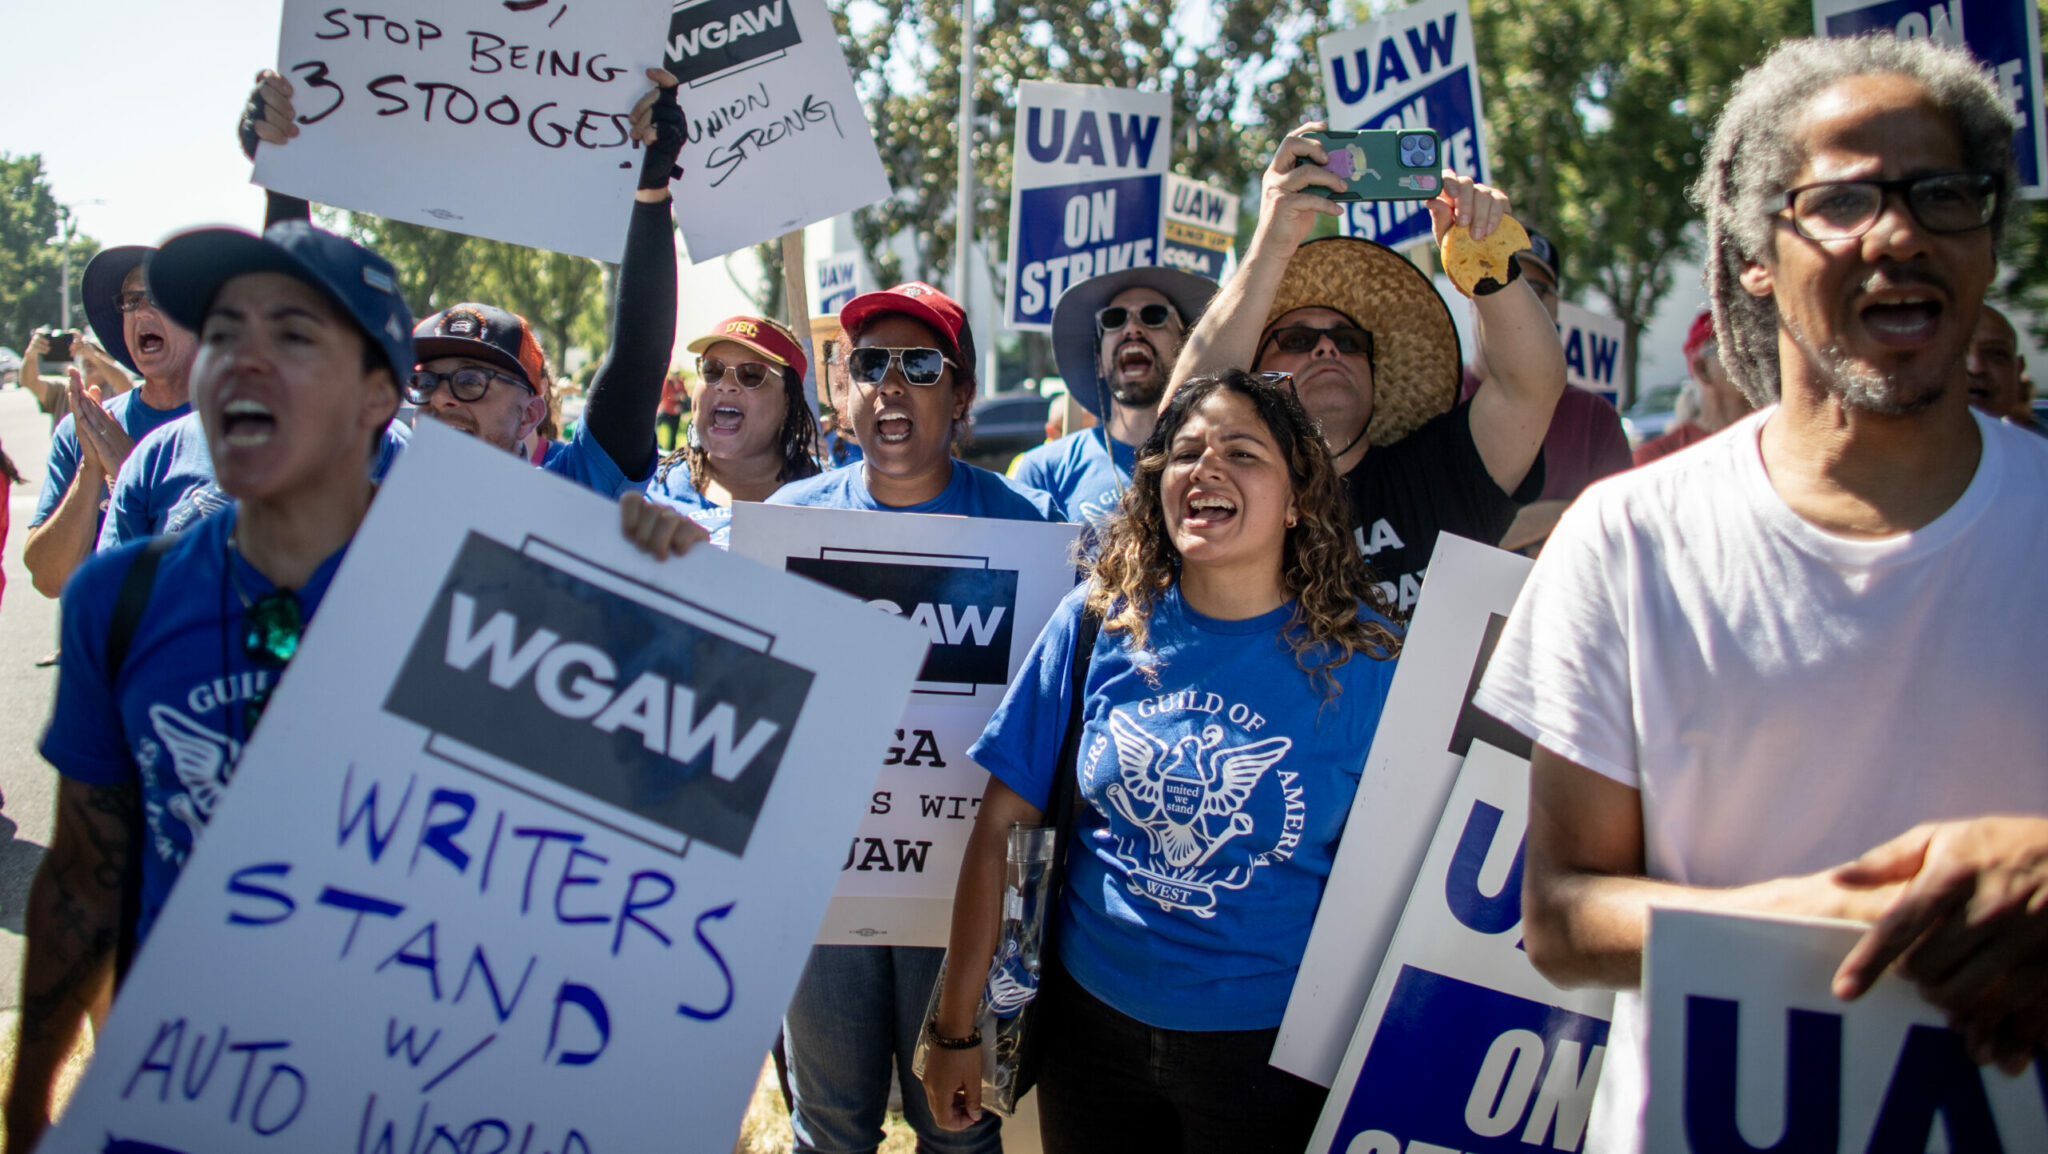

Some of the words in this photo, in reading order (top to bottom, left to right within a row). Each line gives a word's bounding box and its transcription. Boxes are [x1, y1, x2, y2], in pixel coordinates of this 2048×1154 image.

[315, 8, 443, 52] STOP
[467, 31, 629, 82] BEING
[666, 0, 784, 62] WGAW
[1330, 13, 1457, 105] UAW
[292, 60, 345, 126] 3
[705, 94, 845, 188] STRONG
[1026, 106, 1161, 169] UAW
[1064, 188, 1117, 249] ON
[1173, 184, 1226, 225] UAW
[1163, 246, 1211, 274] COLA
[1557, 322, 1619, 385] AW
[187, 670, 268, 714] GUI
[443, 591, 781, 783] WGAW
[884, 728, 946, 768] GA
[1138, 690, 1225, 719] GUILD
[1228, 702, 1267, 732] OF
[1253, 768, 1305, 867] AMERICA
[1166, 783, 1200, 798] united
[1166, 802, 1194, 815] stand
[1174, 796, 1189, 805] we
[336, 762, 736, 1021] WRITERS
[1146, 879, 1192, 904] WEST
[226, 862, 610, 1067] STAND
[121, 1017, 308, 1138] AUTO
[1465, 1028, 1607, 1153] ON
[1682, 994, 2048, 1154] UA
